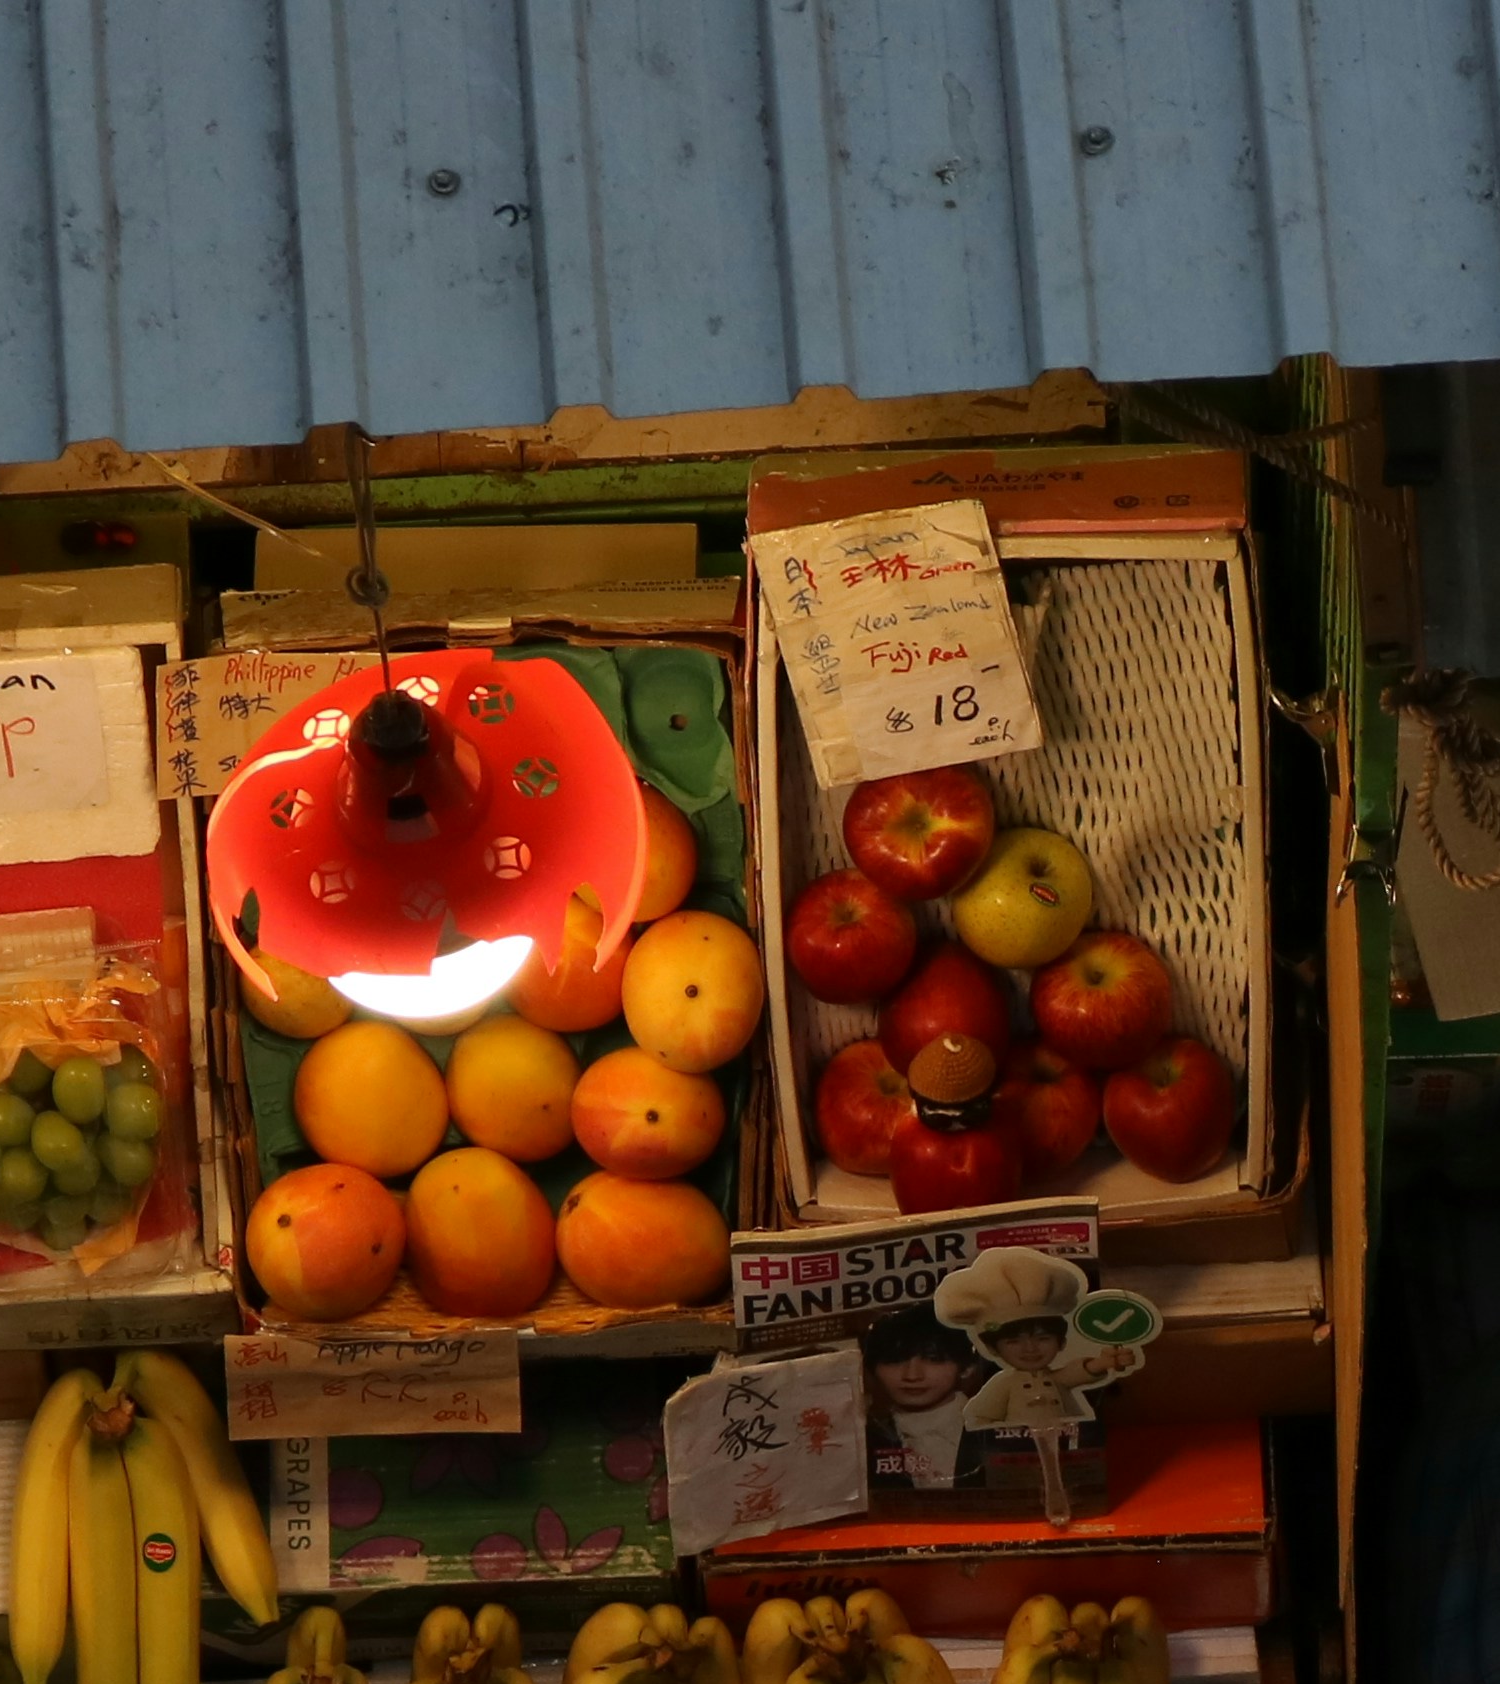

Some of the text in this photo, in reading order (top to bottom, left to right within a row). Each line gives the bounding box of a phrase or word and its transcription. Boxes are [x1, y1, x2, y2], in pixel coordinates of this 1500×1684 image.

[783, 556, 823, 617] 日本
[839, 553, 978, 588] 王林 Green
[850, 610, 899, 639] New
[860, 641, 970, 674] Fuji Red
[218, 692, 276, 720] 特大
[740, 1251, 841, 1290] 中国
[845, 1232, 967, 1277] STAR
[743, 1292, 833, 1325] FAN
[286, 1437, 311, 1550] GRAPES
